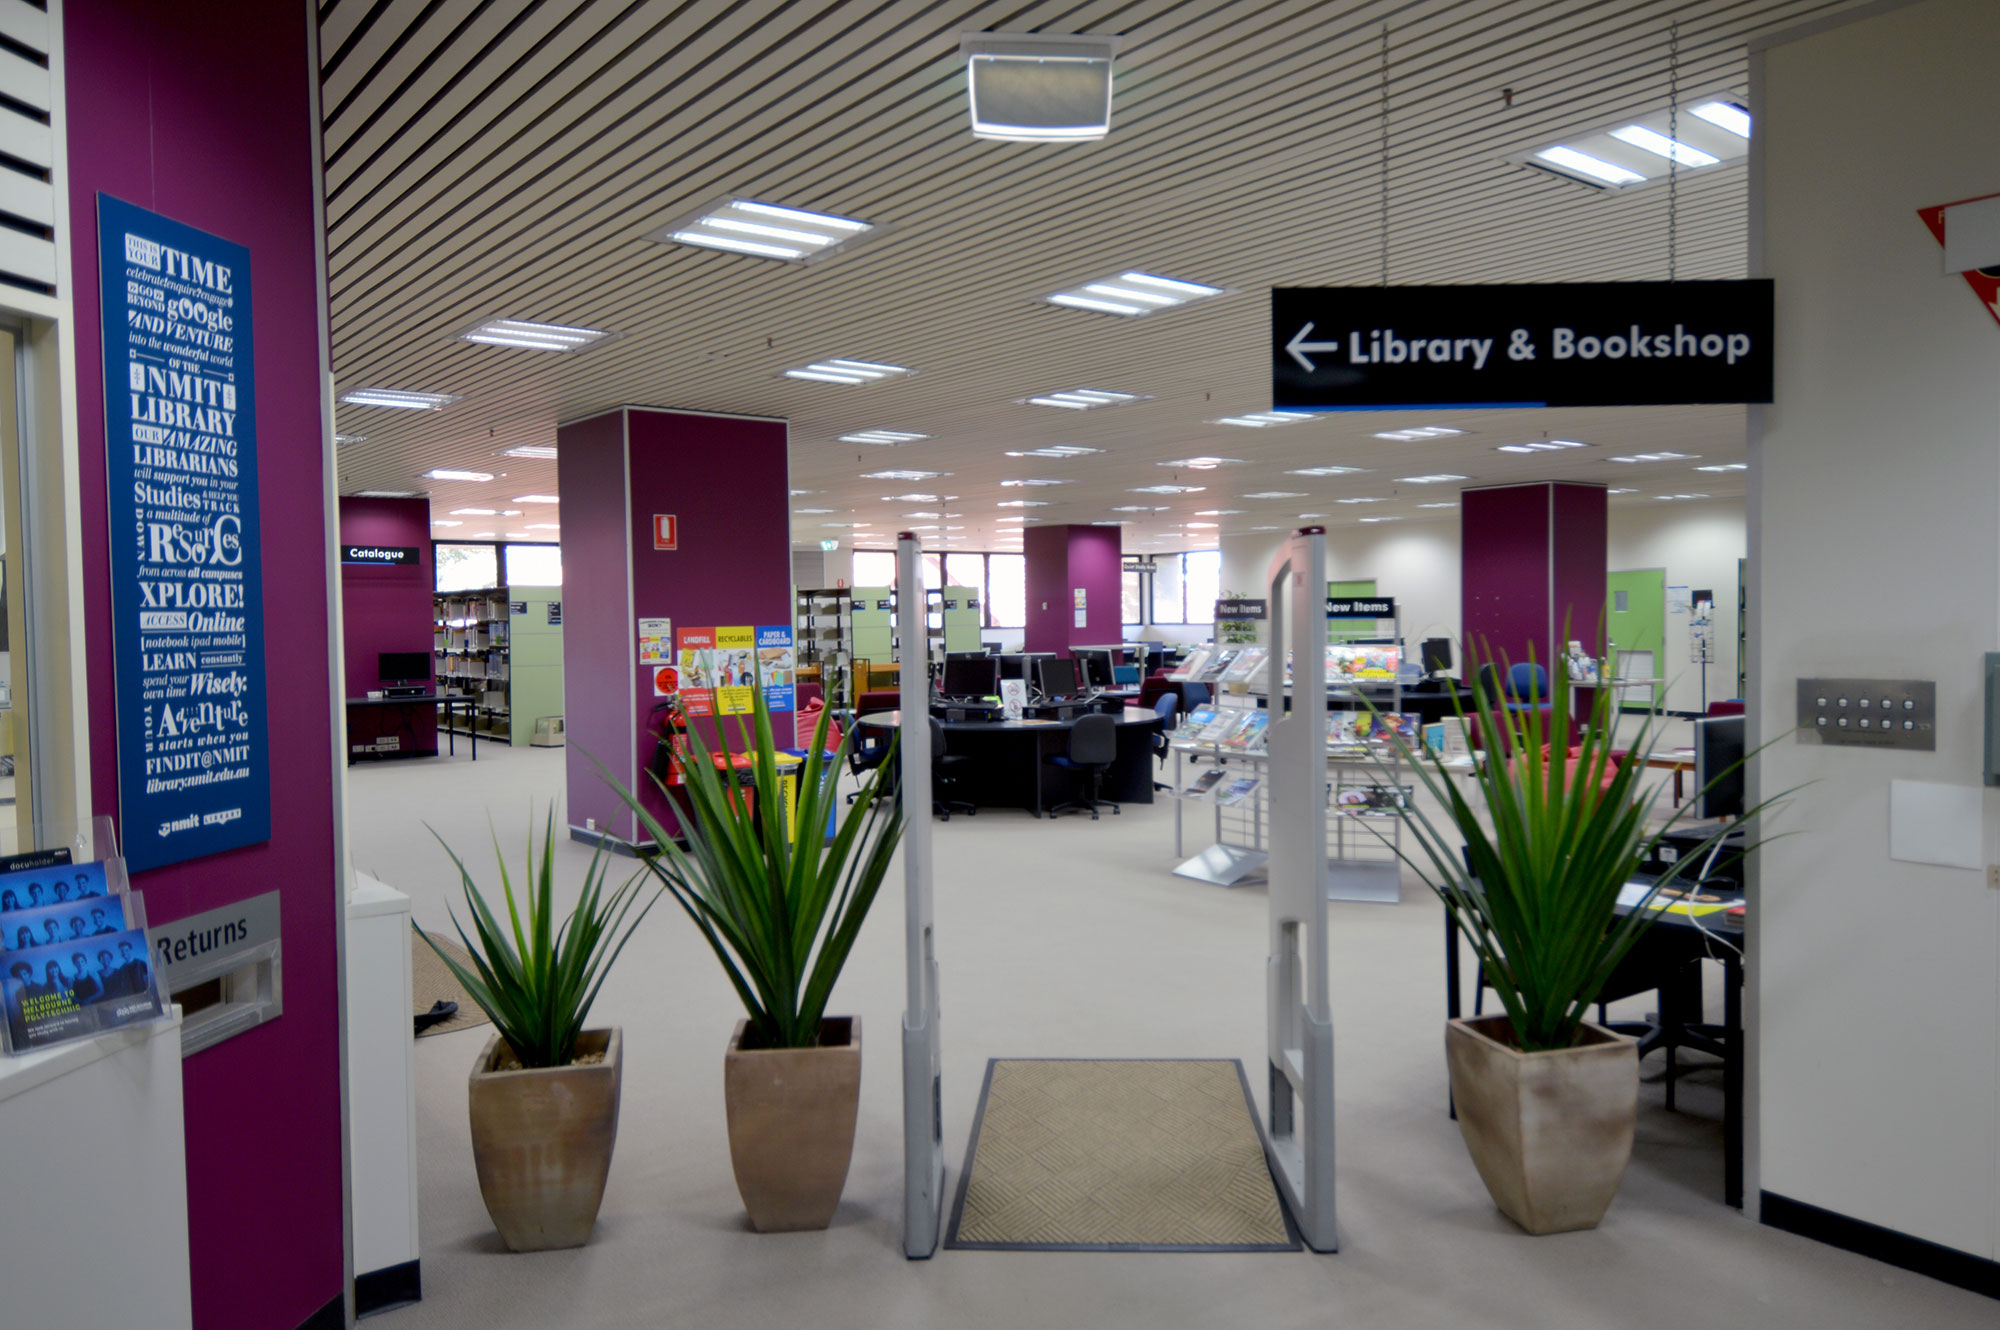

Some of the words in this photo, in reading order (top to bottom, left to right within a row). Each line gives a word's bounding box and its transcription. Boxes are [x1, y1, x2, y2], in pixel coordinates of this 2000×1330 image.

[128, 248, 158, 266] YOUR
[160, 245, 232, 294] TIME
[139, 284, 152, 297] GO
[128, 292, 164, 312] BEYOND
[128, 331, 146, 346] into
[148, 336, 162, 350] the
[163, 342, 209, 363] wonderful
[210, 354, 234, 368] world
[1349, 328, 1494, 370] Library
[1507, 328, 1536, 362] &
[1552, 324, 1751, 365] Bookshop
[169, 357, 180, 369] OF
[181, 361, 201, 374] THE
[147, 366, 221, 406] NMIT
[130, 393, 236, 437] LIBRARY
[135, 427, 159, 442] OUR
[163, 430, 238, 456] AMAZING
[133, 444, 238, 478] LIBRARIANS
[134, 467, 152, 479] will
[153, 471, 190, 486] support
[191, 476, 208, 488] you
[210, 477, 218, 488] in
[220, 480, 238, 491] your
[134, 482, 201, 510] Studies
[202, 500, 240, 514] TRACK
[146, 511, 153, 520] a
[155, 509, 201, 523] multitude
[202, 513, 212, 526] of
[136, 508, 145, 560] DOWN
[350, 548, 404, 560] Catalogue
[136, 564, 160, 579] from
[161, 566, 187, 578] across
[188, 566, 200, 579] all
[201, 569, 243, 582] campuses
[140, 582, 244, 608] XPLORE!
[1219, 604, 1238, 614] New
[1239, 604, 1262, 614] Items
[1352, 601, 1389, 612] Items
[144, 612, 185, 627] ACCESS
[188, 612, 244, 632] Online
[190, 636, 210, 648] ipad
[683, 636, 711, 645] LANDFILL
[718, 635, 752, 643] RECYCLABLES
[758, 638, 791, 646] CARDBOARD
[142, 652, 197, 671] LEARN
[200, 653, 244, 665] constantly
[142, 674, 168, 688] spend
[169, 676, 190, 686] your
[143, 690, 164, 700] own
[166, 687, 186, 698] time
[144, 705, 154, 752] YOUR
[158, 737, 193, 752] starts
[197, 734, 226, 746] when
[228, 731, 248, 744] you
[146, 744, 250, 775] FINDIT@NMIT
[146, 767, 250, 794] library.nmit.edu.au
[171, 813, 200, 832] nmit
[204, 809, 241, 824] LIBRARY
[10, 857, 54, 870] docuholder
[156, 918, 248, 967] Returns
[20, 992, 62, 1007] WELCOME
[64, 988, 74, 999] TO
[23, 998, 72, 1015] MELBOURNE
[24, 1004, 80, 1023] POLYTECHNIC
